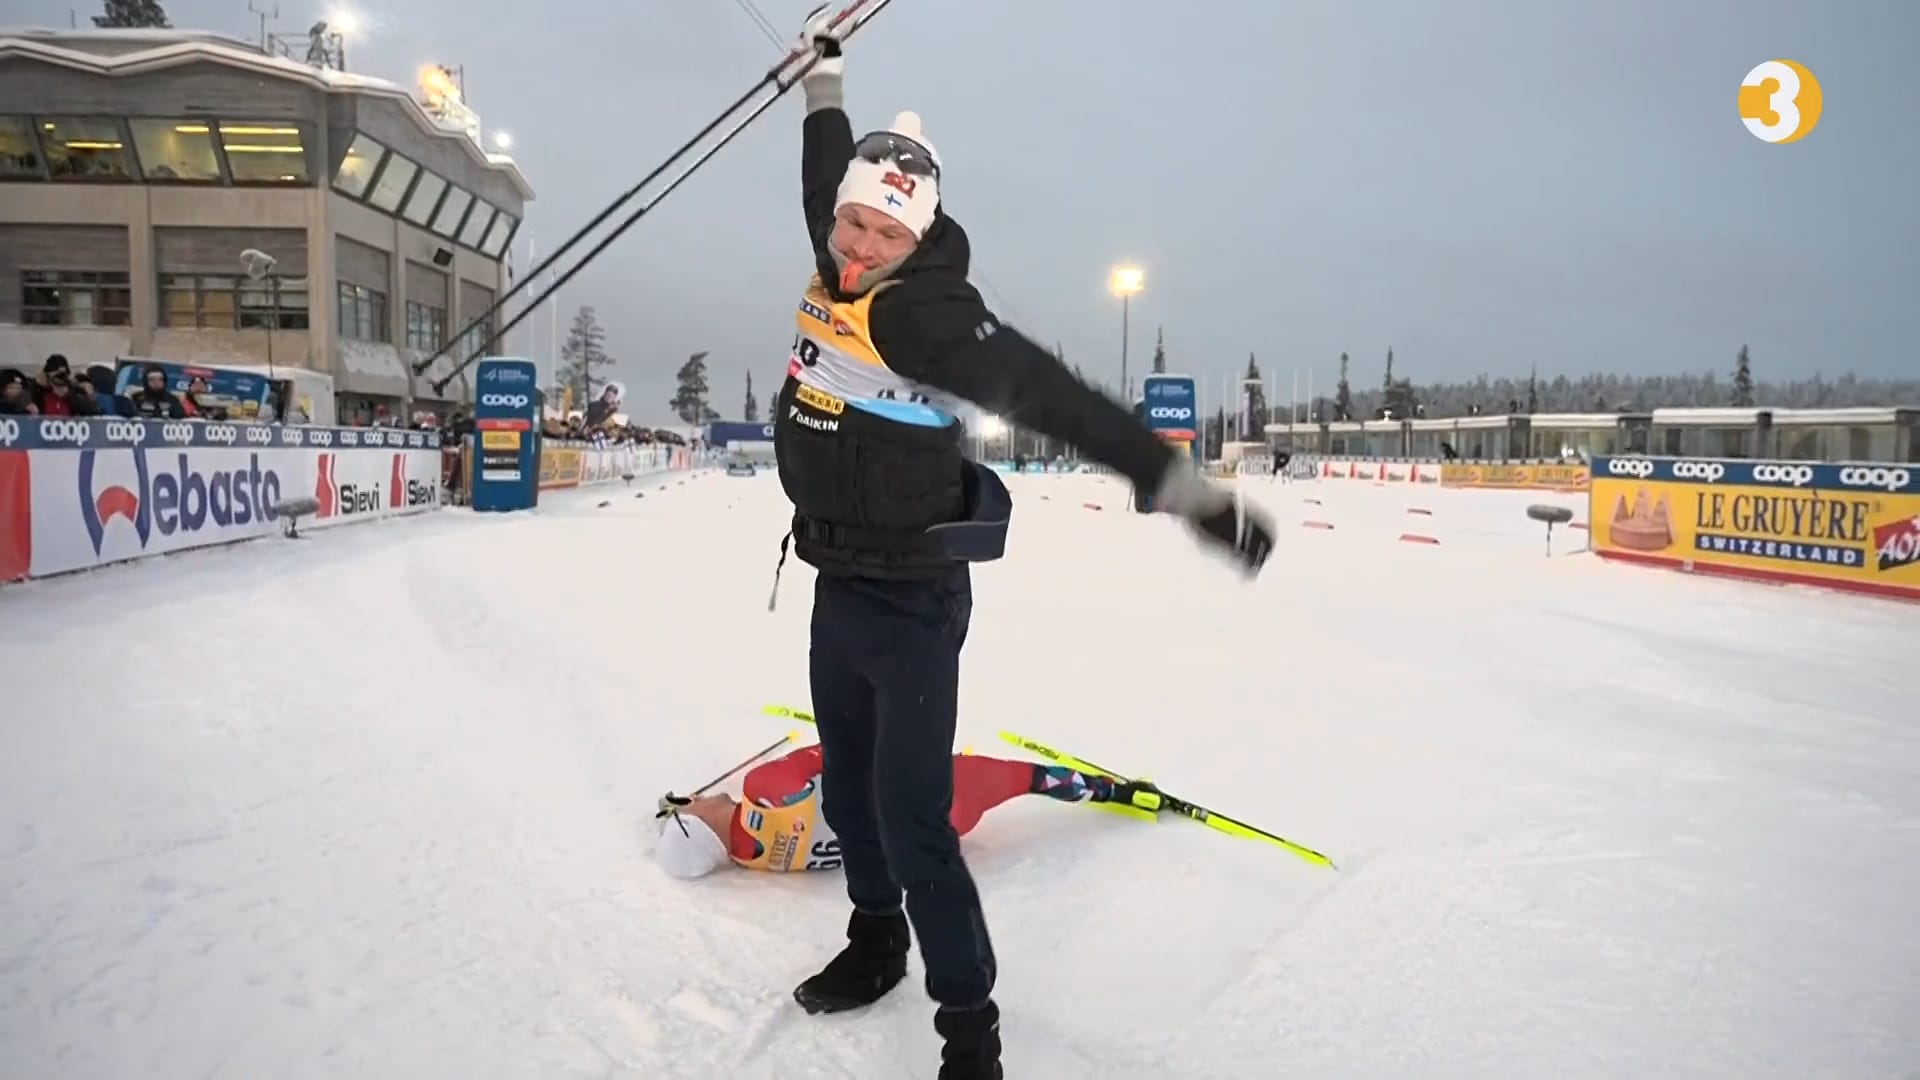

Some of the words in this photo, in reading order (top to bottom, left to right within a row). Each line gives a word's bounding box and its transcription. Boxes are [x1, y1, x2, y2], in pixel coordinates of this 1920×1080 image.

[482, 394, 528, 409] coop
[1151, 407, 1191, 420] coop
[40, 420, 89, 446] coop
[106, 422, 146, 446] coop
[162, 424, 193, 445] coop
[205, 425, 236, 445] coop
[246, 426, 272, 446] coop
[310, 430, 332, 447] coop
[796, 412, 839, 432] DAIKIN
[1609, 459, 1654, 477] coop
[1673, 461, 1725, 482] coop
[1752, 464, 1814, 486] coop
[1839, 467, 1911, 490] coop
[340, 482, 380, 515] Sievi
[408, 479, 436, 505] Sievi
[1697, 492, 1725, 529] LE
[1732, 490, 1870, 542] GRUYÈRE
[1700, 534, 1858, 565] SWITZERLAND
